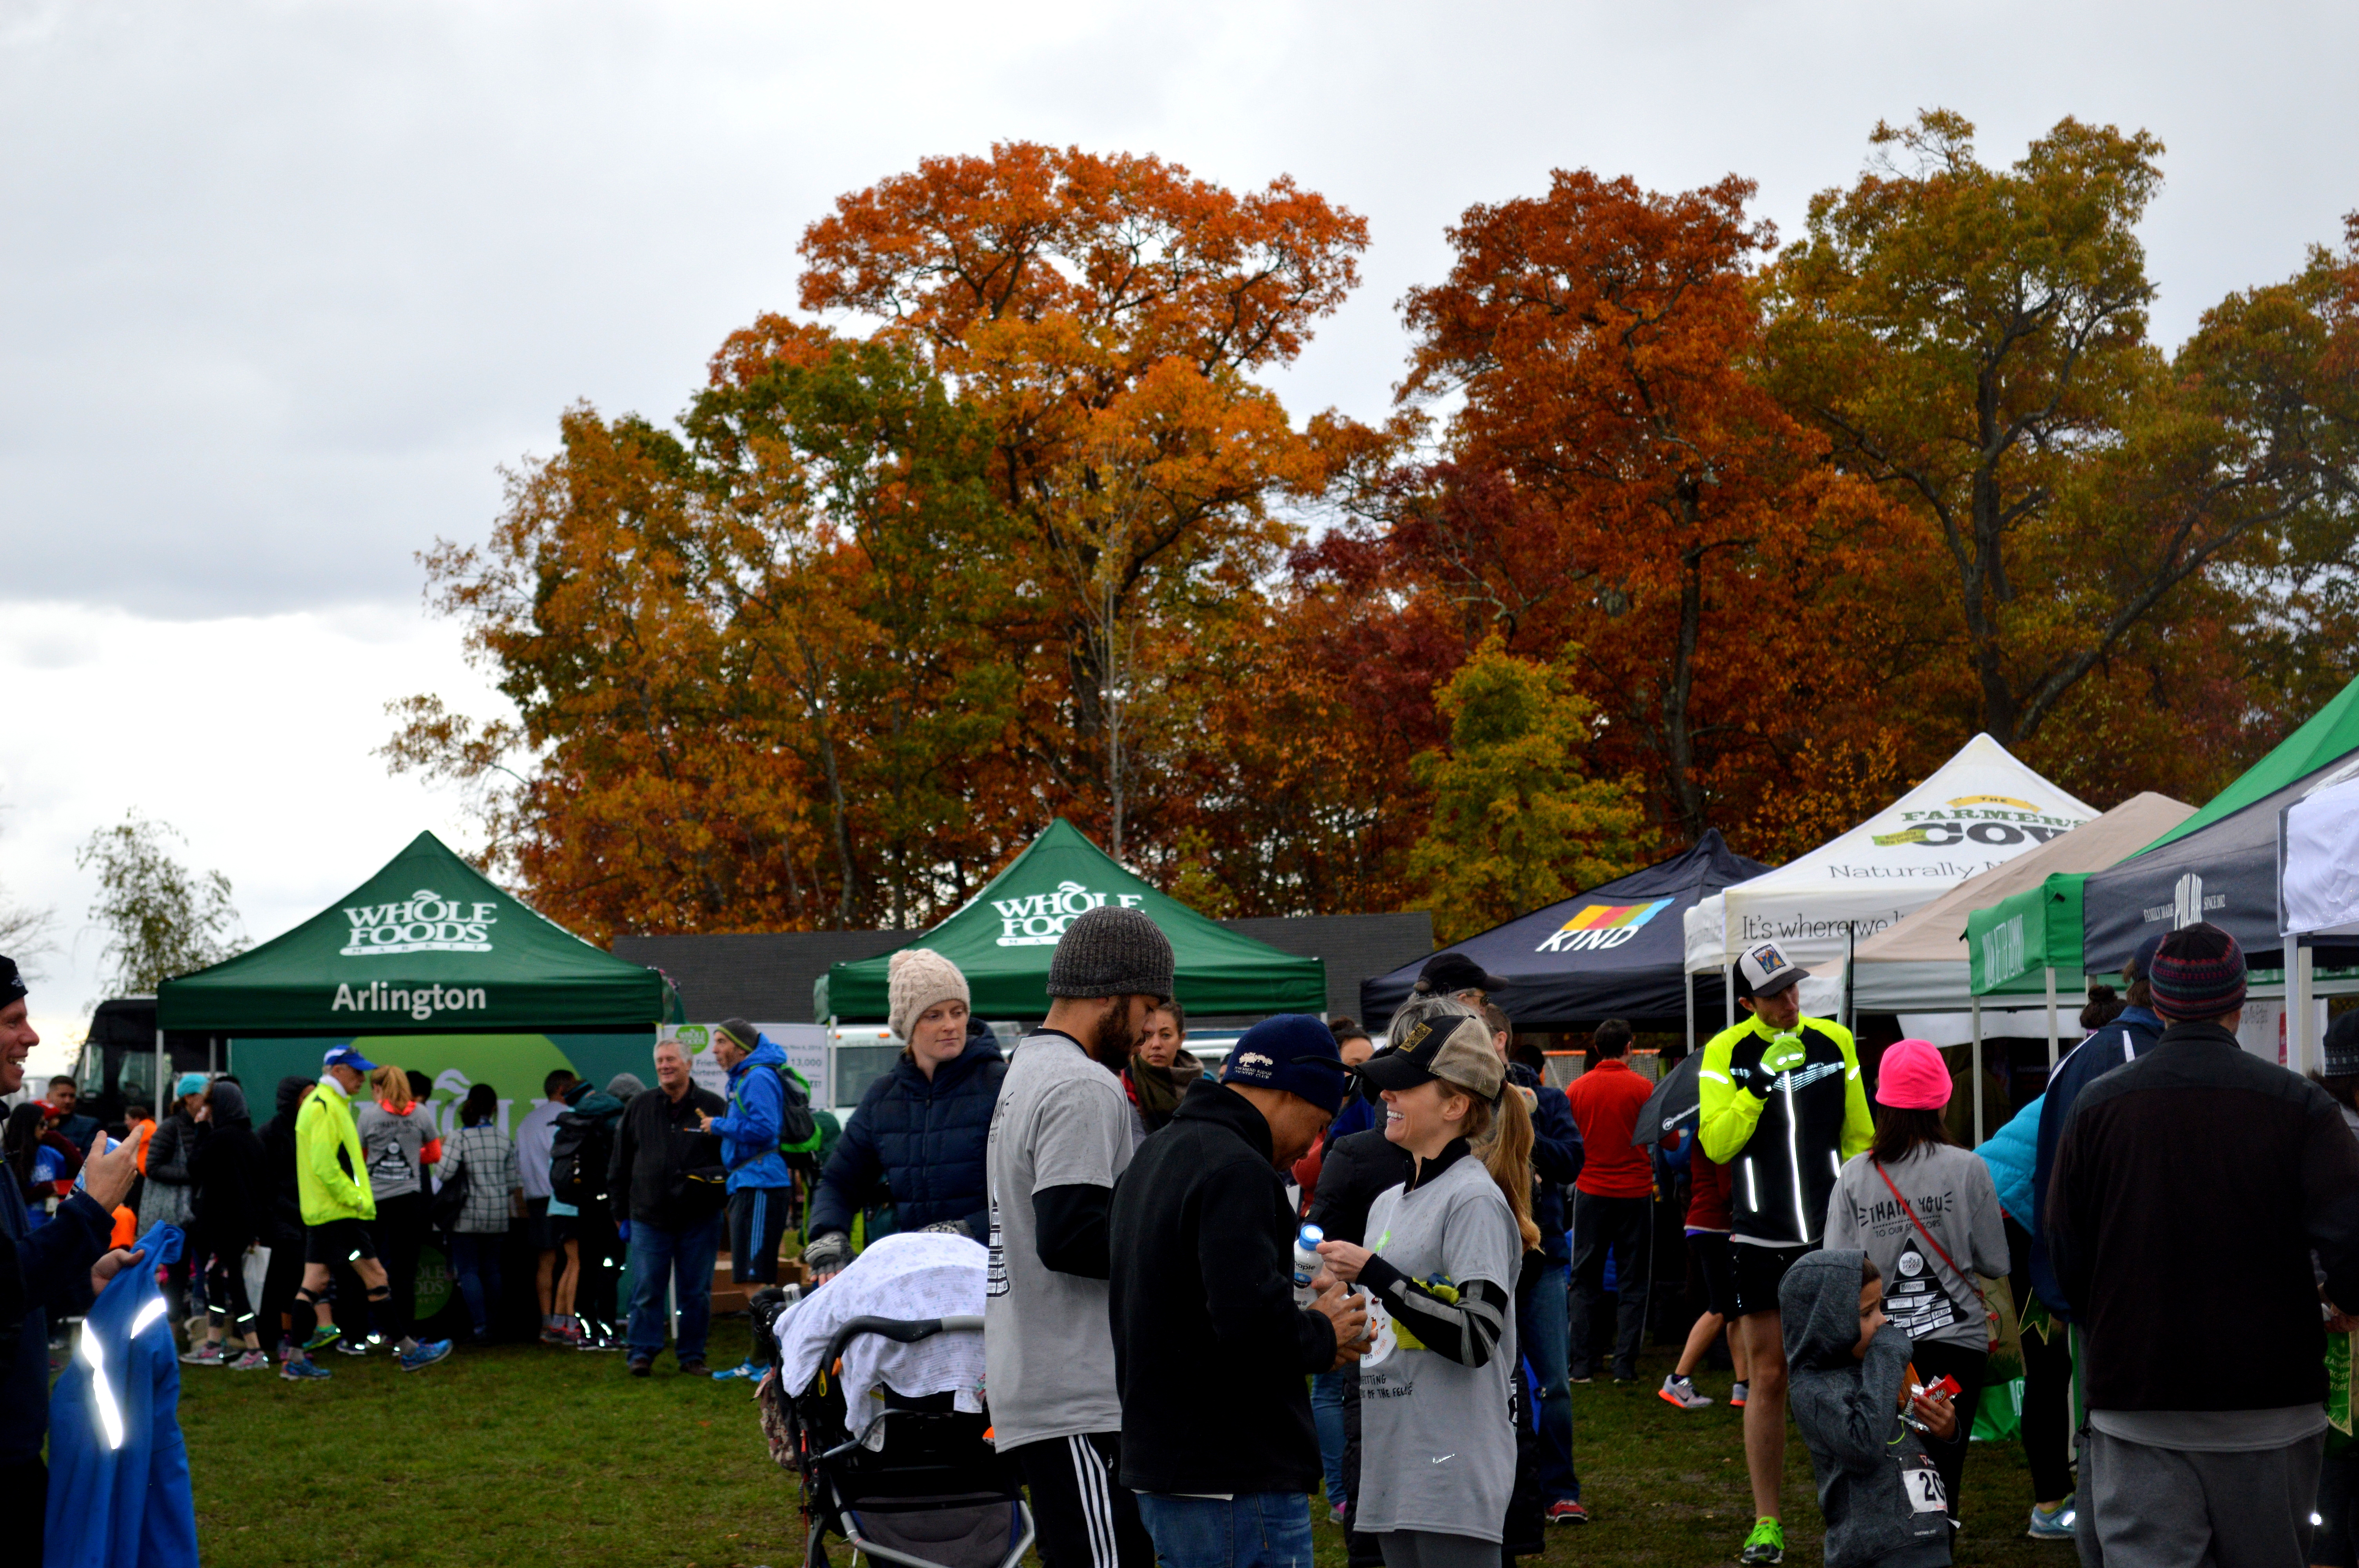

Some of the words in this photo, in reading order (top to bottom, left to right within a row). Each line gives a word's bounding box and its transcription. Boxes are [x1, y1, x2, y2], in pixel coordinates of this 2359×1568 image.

[1828, 862, 1975, 879] Naturally
[343, 900, 498, 928] WHOLE
[2174, 873, 2203, 931] POLAR
[347, 922, 488, 947] FOODS
[1535, 925, 1639, 952] KIND
[1743, 915, 1772, 939] It's
[1778, 913, 1848, 937] where
[1854, 920, 1888, 936] we
[331, 981, 486, 1020] Arlington
[1918, 1196, 1943, 1213] YOU
[1876, 1229, 1886, 1238] TO
[1888, 1225, 1903, 1235] OUR
[1905, 1220, 1941, 1231] SPOSORS
[1367, 1389, 1375, 1399] OF
[1377, 1388, 1390, 1399] THE
[2330, 1381, 2349, 1391] TORE
